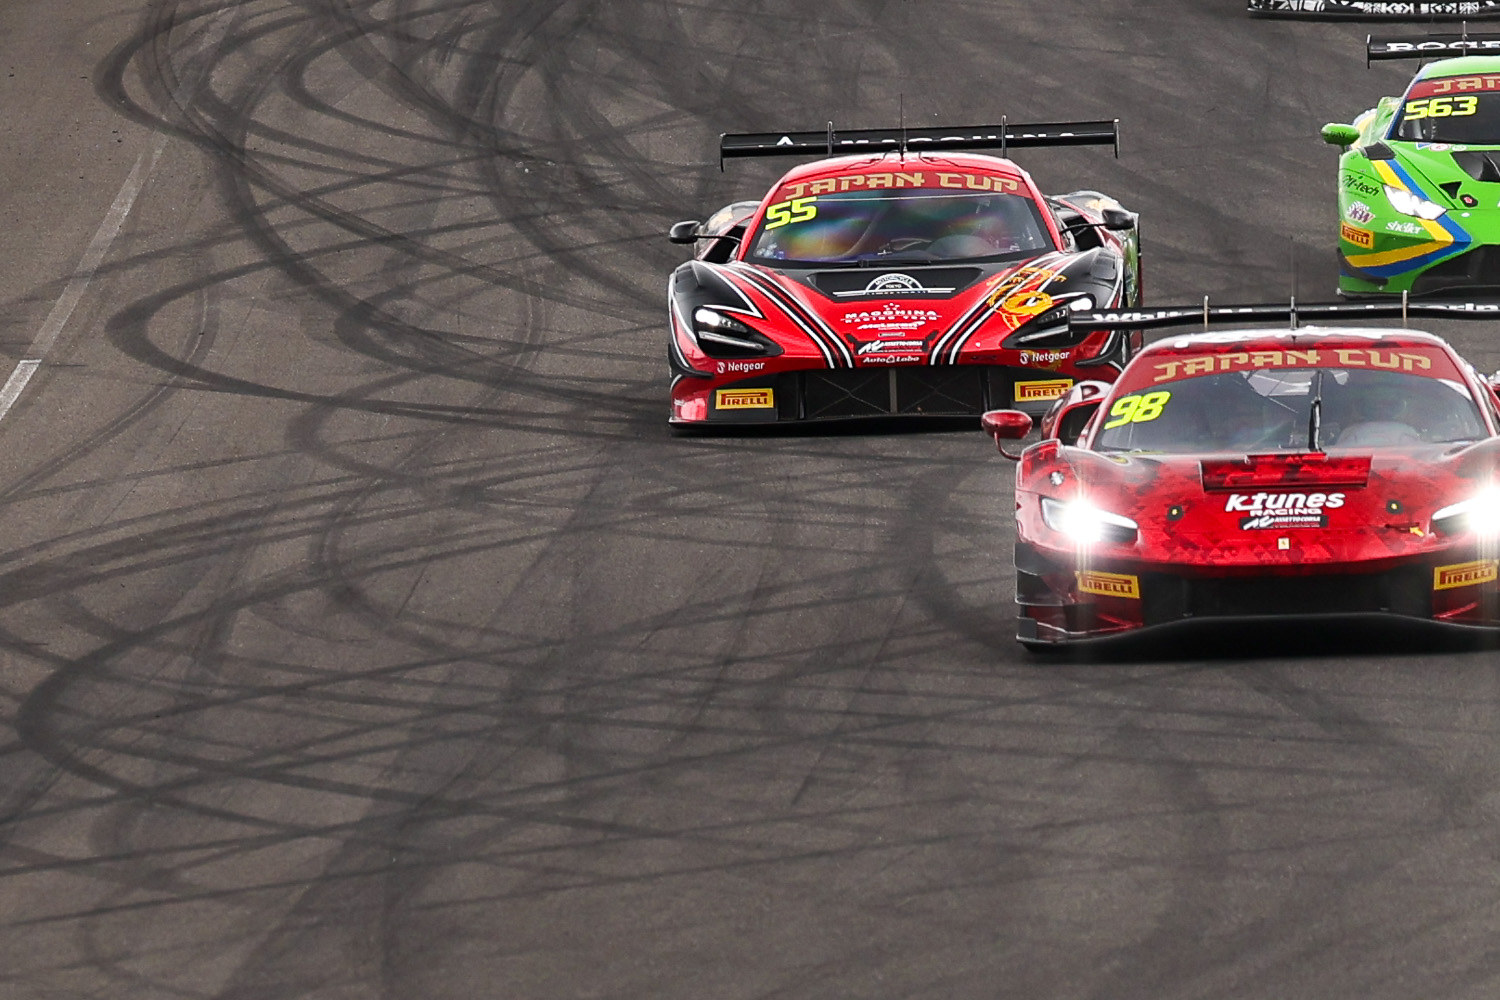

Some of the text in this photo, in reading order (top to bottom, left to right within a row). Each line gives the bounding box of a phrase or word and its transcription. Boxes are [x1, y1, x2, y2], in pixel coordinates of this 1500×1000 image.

[1404, 96, 1478, 120] 563
[785, 172, 1019, 200] JAPAN CUP
[765, 195, 818, 230] 55
[1341, 225, 1370, 245] PIRELLI
[727, 362, 765, 372] Netgear
[1153, 350, 1433, 382] JAPAN CUP
[720, 392, 768, 406] PIRELLI
[1020, 383, 1068, 397] PIREL
[1104, 391, 1171, 430] 98
[1249, 507, 1322, 517] RACING
[1081, 573, 1133, 593] PIRELLI
[1439, 562, 1493, 585] PIRELLI
